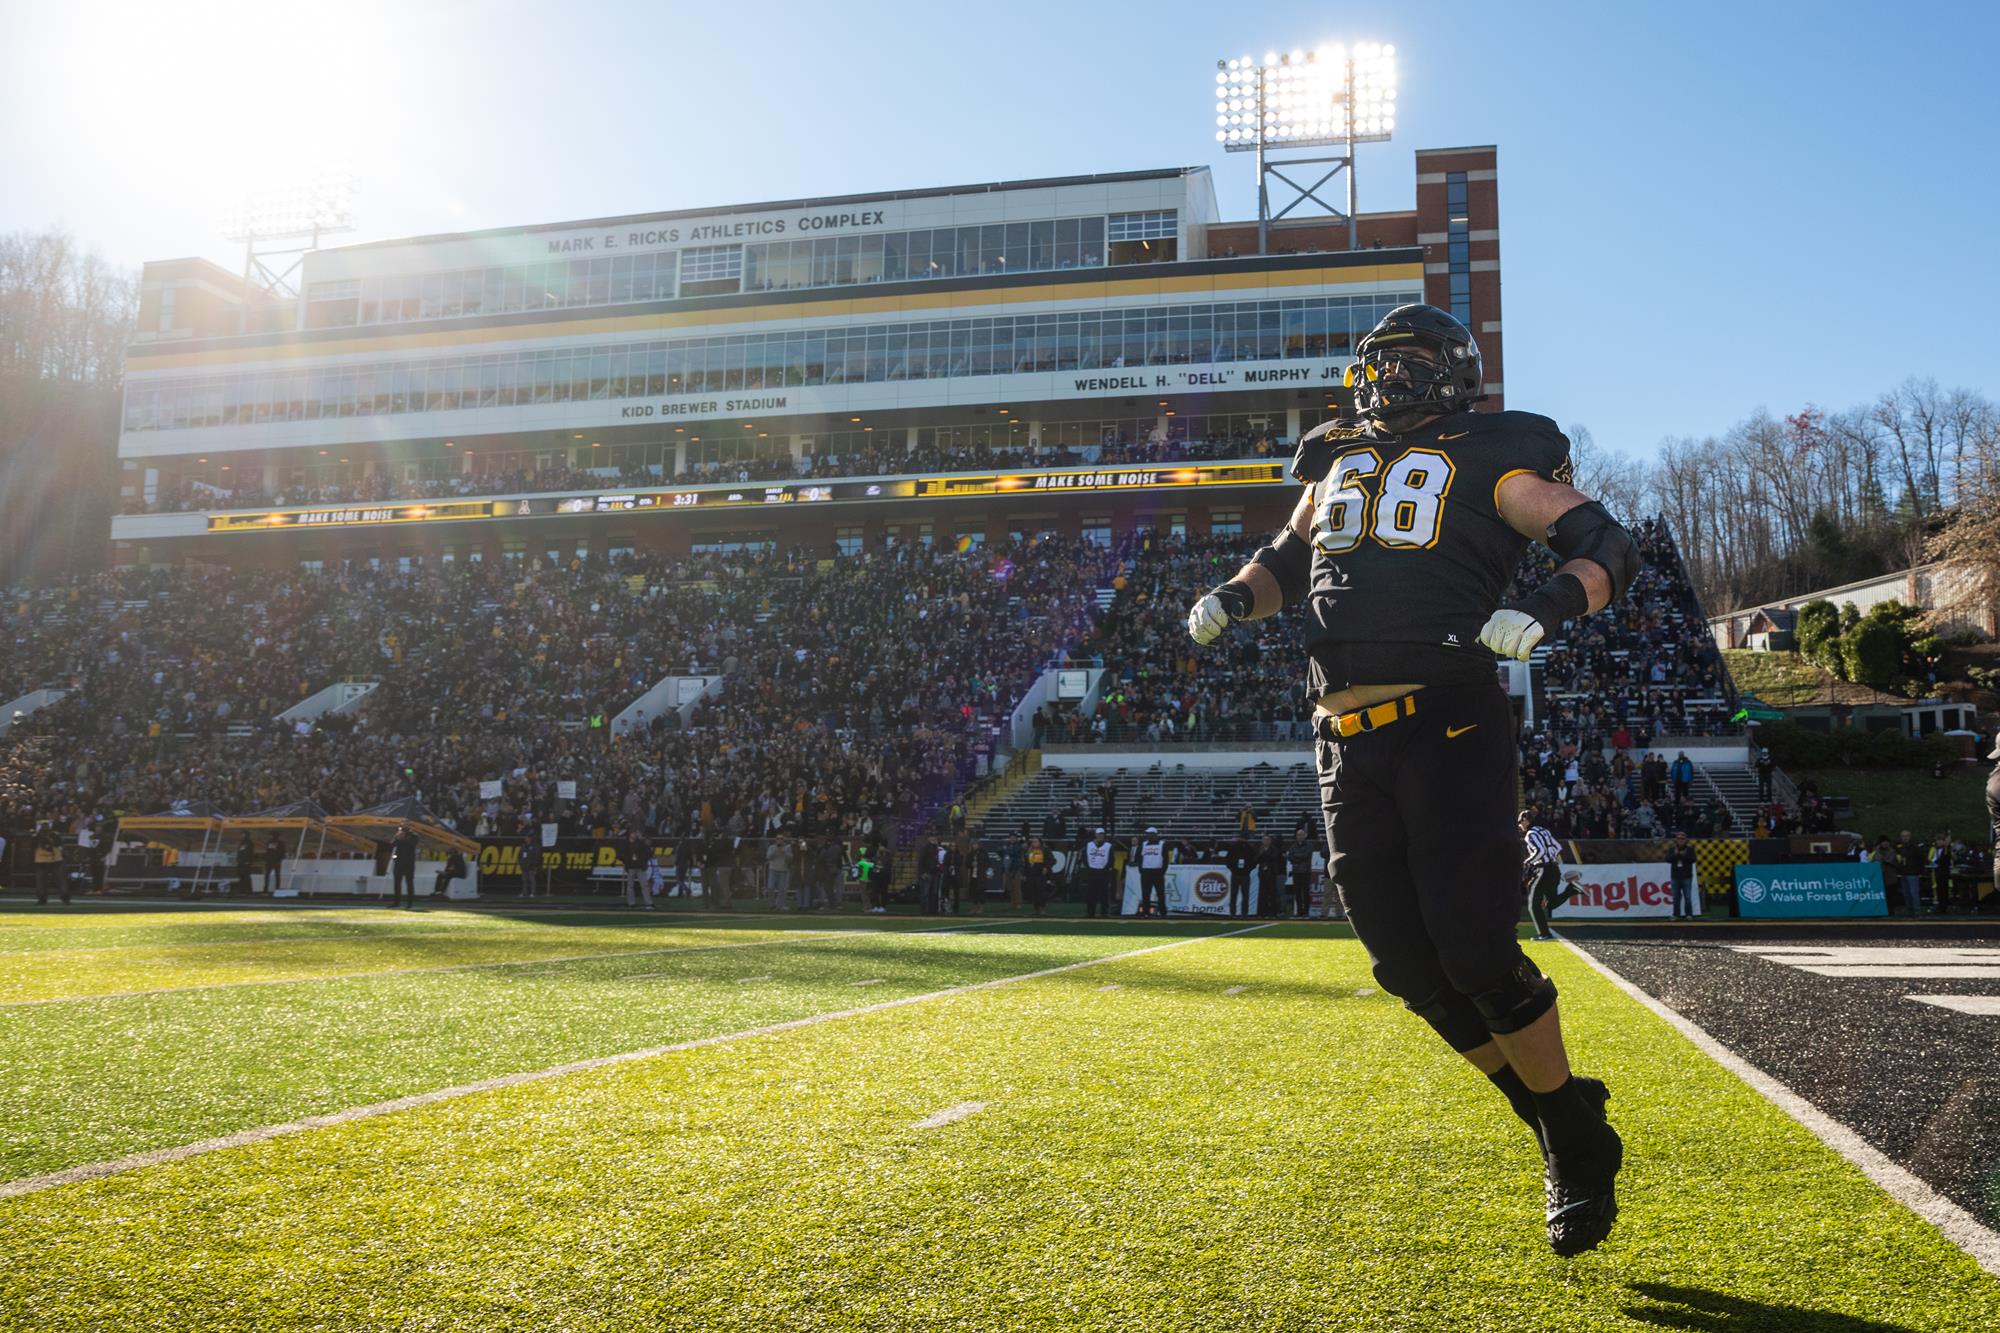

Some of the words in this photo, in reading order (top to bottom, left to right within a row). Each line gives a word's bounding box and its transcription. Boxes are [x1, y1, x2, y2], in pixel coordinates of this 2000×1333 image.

[548, 237, 593, 254] MARK
[605, 236, 618, 248] E.
[628, 229, 679, 246] RICKS
[690, 219, 786, 241] ATHLETICS
[798, 211, 884, 232] COMPLEX
[1075, 376, 1147, 391] WENDELL
[1156, 375, 1170, 387] H.
[1178, 370, 1235, 386] "DELL"
[1245, 368, 1311, 383] MURPHY
[622, 406, 654, 418] KIDD
[661, 401, 717, 416] BREWER
[726, 397, 787, 412] STADIUM
[1035, 475, 1075, 488] MAKE
[1077, 473, 1113, 486] SOME
[1118, 472, 1157, 485] NOISE
[673, 493, 699, 506] 3:31
[1313, 447, 1456, 554] 68
[297, 511, 330, 524] MAKE
[331, 510, 360, 522] SOME
[362, 509, 393, 521] NOISE
[1448, 633, 1459, 643] XL
[542, 852, 561, 869] TO
[565, 852, 594, 869] THE
[1770, 878, 1822, 891] Atrium
[1823, 877, 1871, 890] Health
[1569, 876, 1673, 911] ngles
[1770, 890, 1804, 902] Wake
[1806, 890, 1842, 901] Forest
[1845, 889, 1886, 903] Baptist
